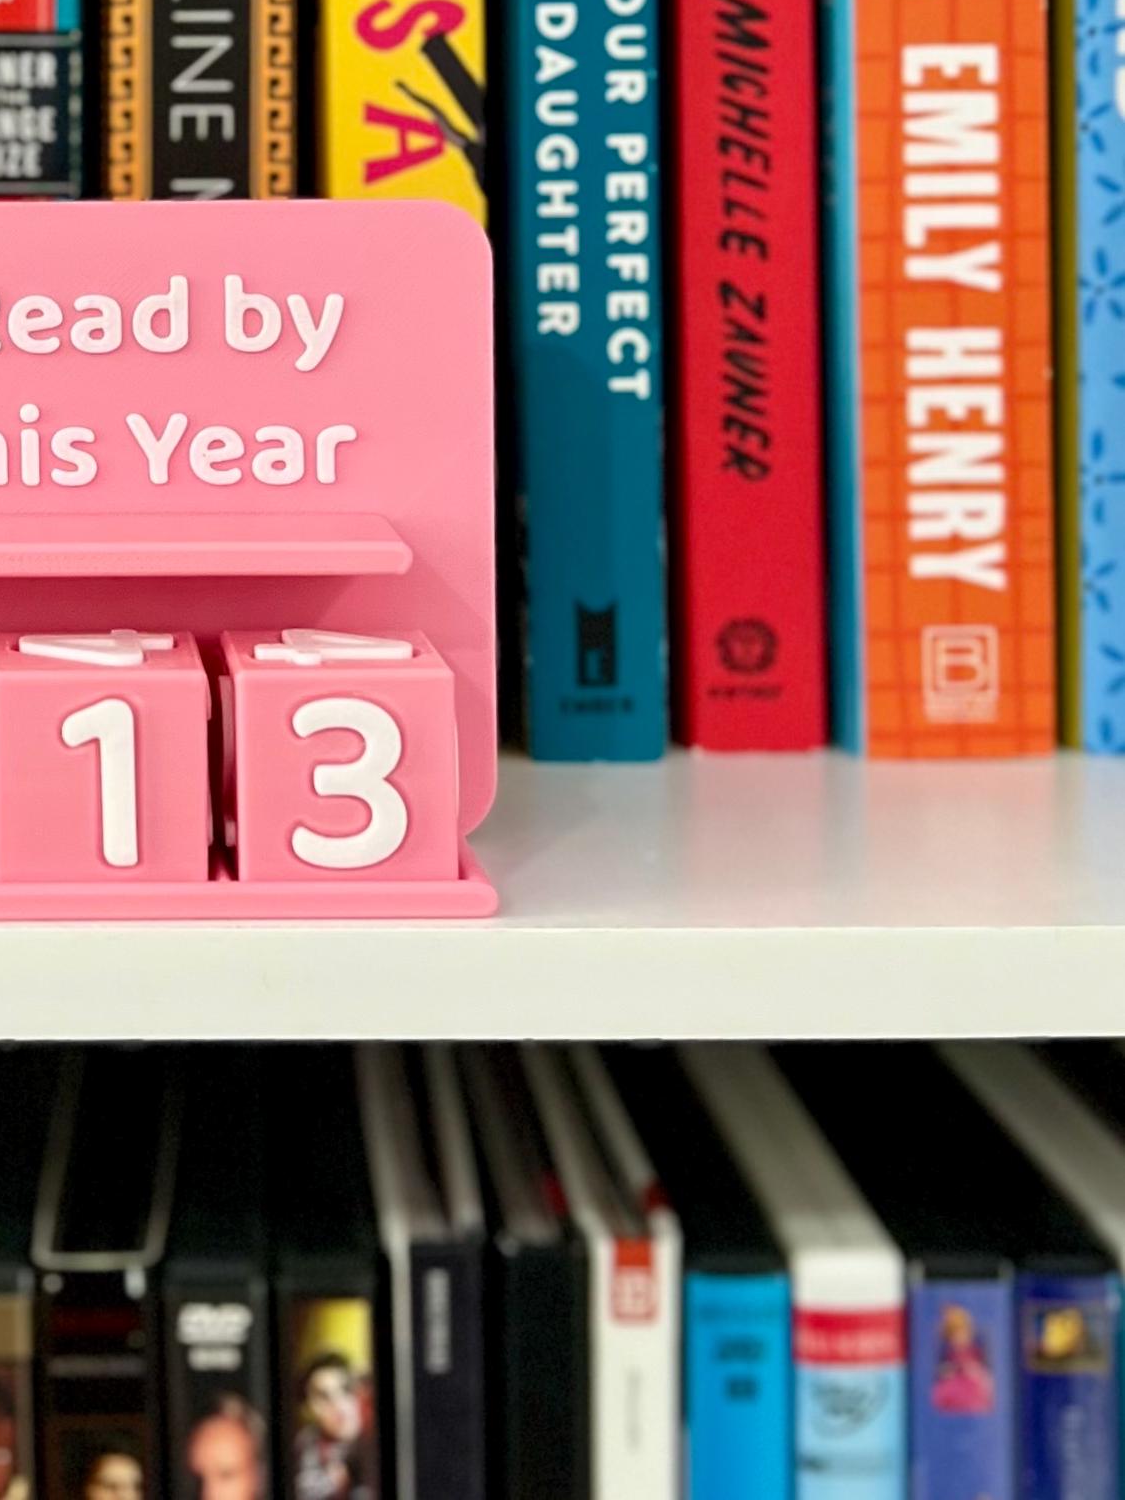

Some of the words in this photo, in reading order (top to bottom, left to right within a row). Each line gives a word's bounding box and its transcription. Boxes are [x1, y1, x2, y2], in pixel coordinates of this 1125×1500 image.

[362, 101, 445, 186] A
[536, 2, 579, 336] DAUGHTER
[900, 44, 1002, 293] EMILY
[224, 274, 345, 372] by
[606, 132, 650, 398] PERFECT
[125, 412, 358, 485] Year
[715, 283, 771, 484] ZAUNER
[904, 327, 1007, 593] HENRY
